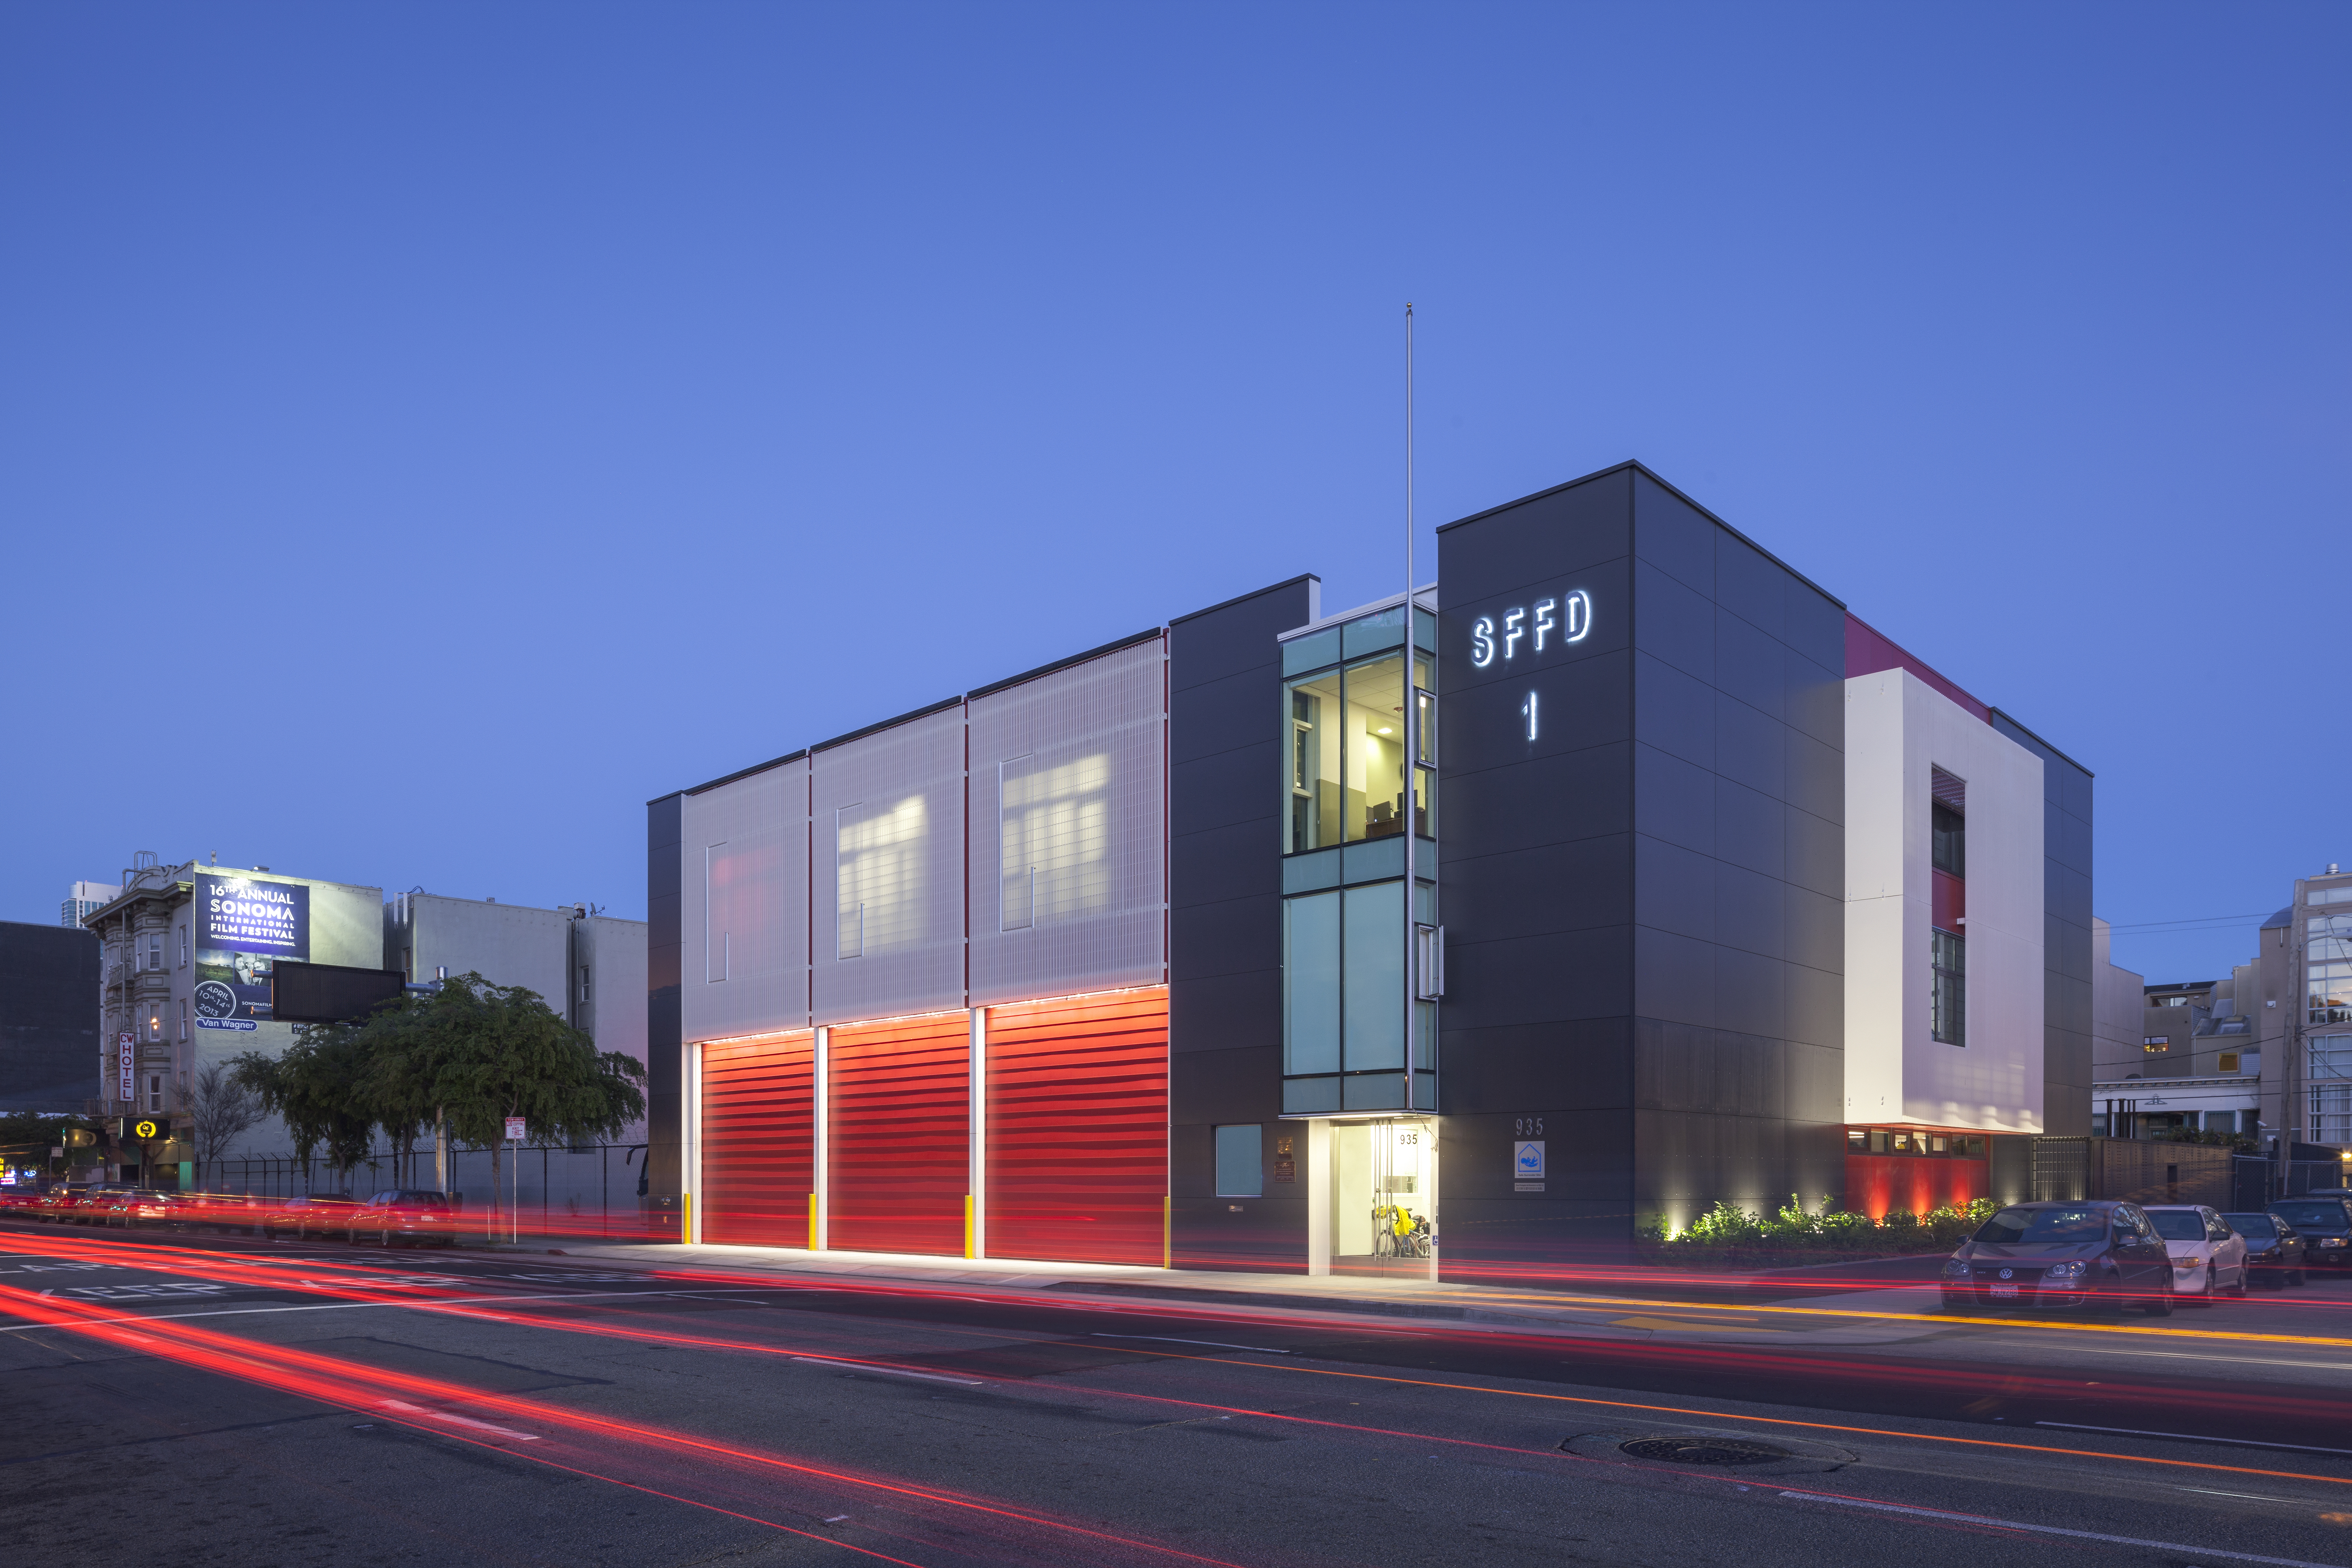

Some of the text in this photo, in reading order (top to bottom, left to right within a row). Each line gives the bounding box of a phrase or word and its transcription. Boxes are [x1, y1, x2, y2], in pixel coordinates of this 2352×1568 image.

[1471, 590, 1591, 667] SFFD
[1522, 690, 1537, 741] 1
[210, 885, 294, 904] 16TH ANNUAL
[210, 899, 294, 921] SONOMA
[211, 915, 294, 928] INTERNATIONAL
[211, 923, 294, 939] FILM FESTIVAL
[207, 986, 228, 1001] APRIL
[199, 1003, 219, 1016] 2013
[221, 1020, 254, 1029] Wagner
[121, 1034, 134, 1043] CW
[121, 1045, 132, 1099] HOTEL
[1516, 1118, 1542, 1135] 935
[1400, 1134, 1417, 1145] 935
[270, 1277, 469, 1290] KEEP
[9, 1283, 227, 1302] KEEP
